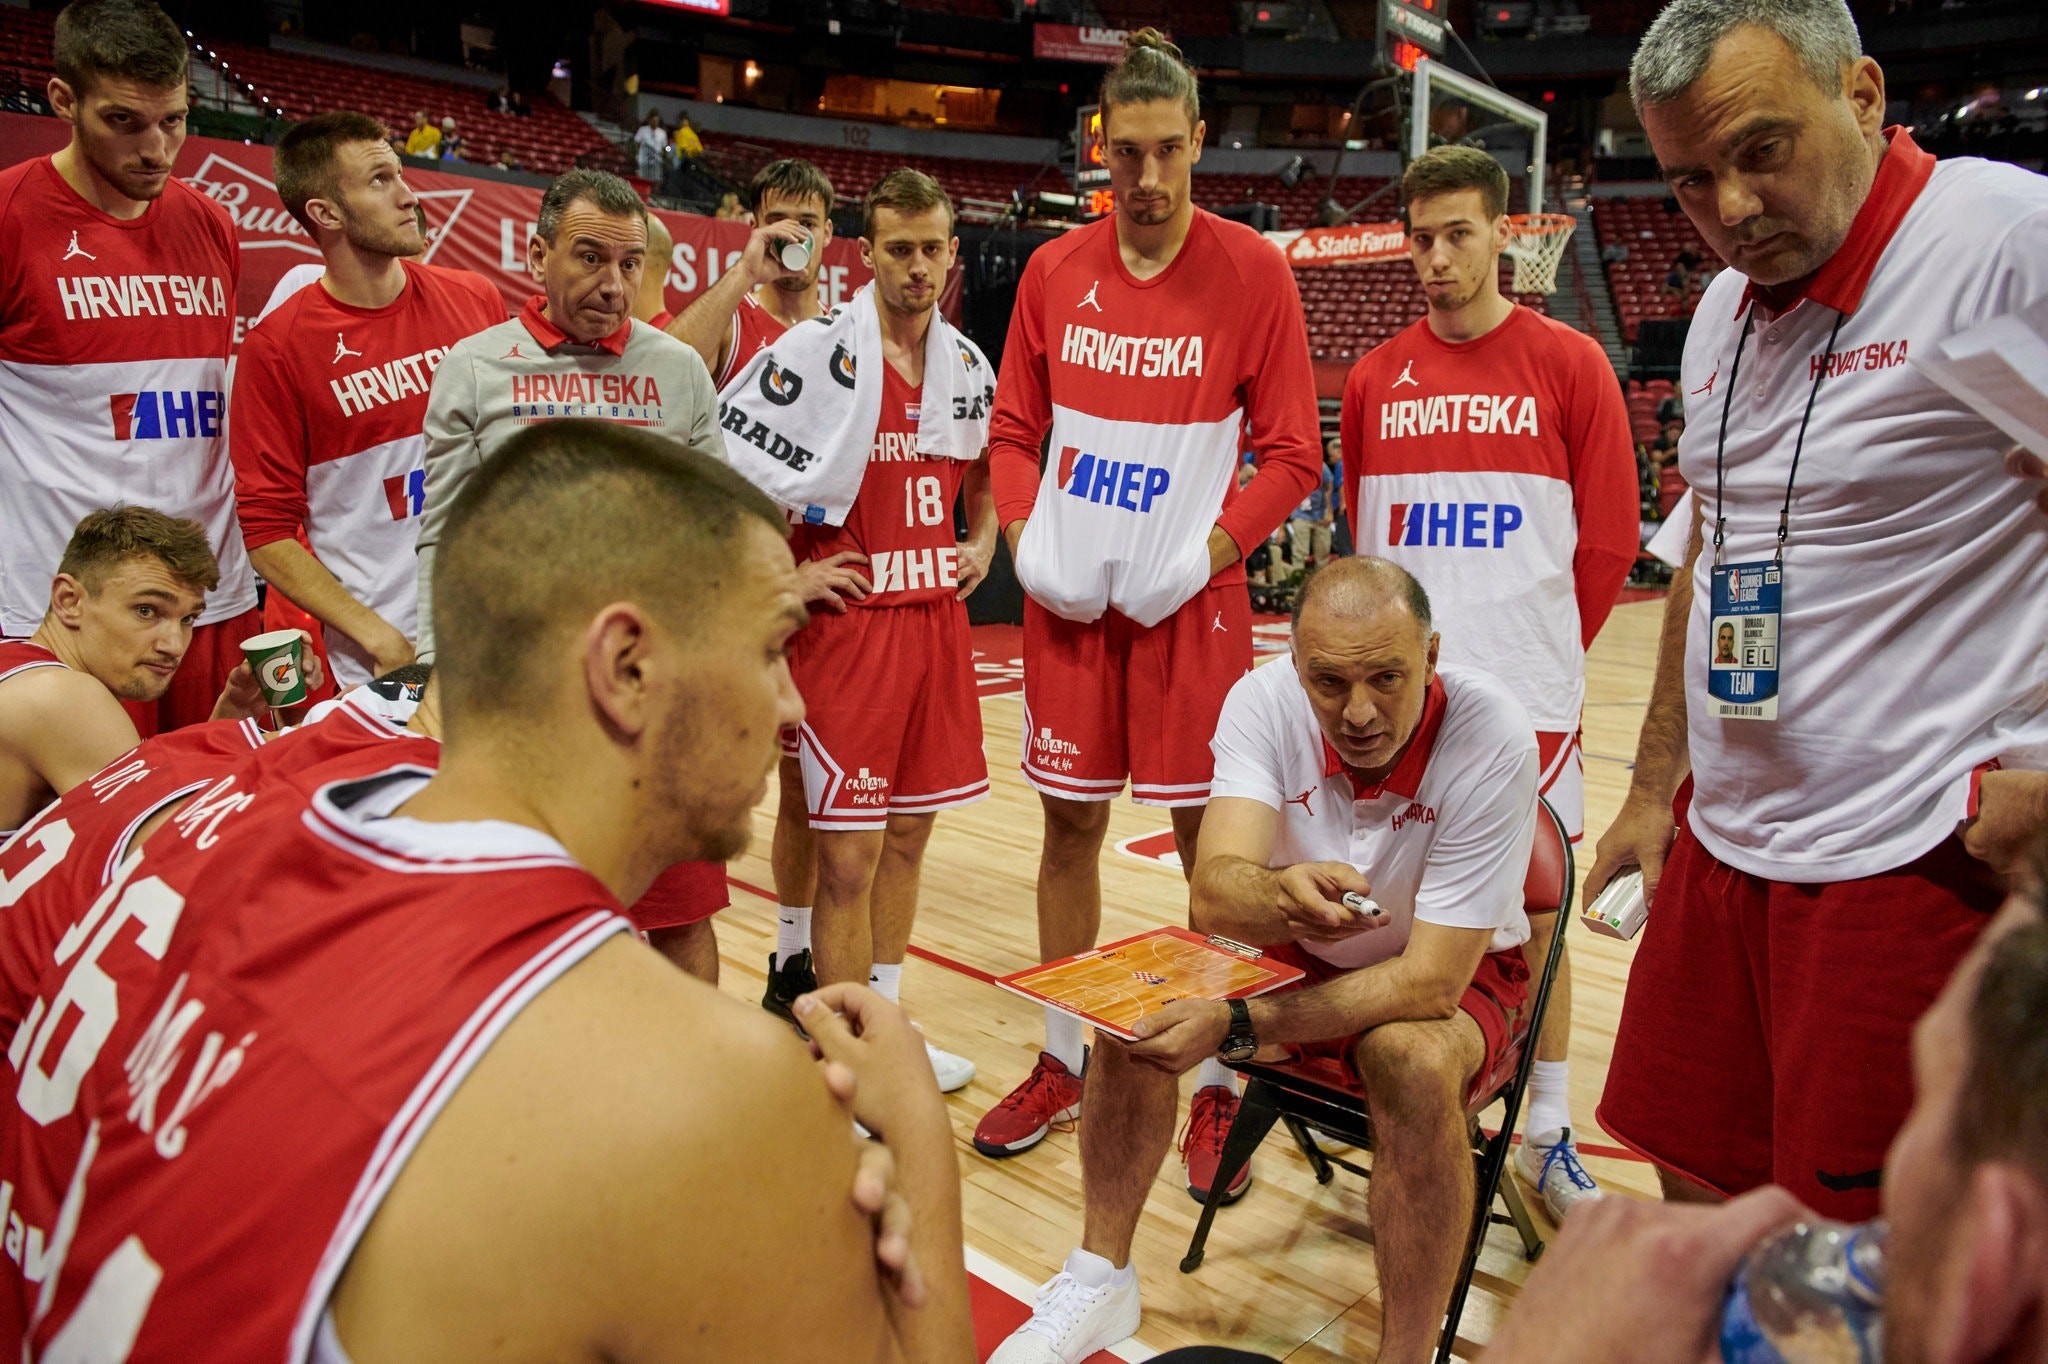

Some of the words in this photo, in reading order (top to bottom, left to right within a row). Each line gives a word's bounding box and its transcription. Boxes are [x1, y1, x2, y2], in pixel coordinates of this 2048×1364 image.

[842, 125, 871, 145] 102
[1316, 235, 1360, 258] State
[1359, 231, 1405, 254] Farm
[57, 275, 227, 320] HRVATSKA
[1061, 324, 1203, 377] HRVATSKA
[1809, 339, 1908, 381] HRVATSKA
[512, 373, 662, 406] HRVATSKA
[513, 405, 663, 419] BASKETBALL
[1380, 394, 1539, 440] HRVATSKA
[905, 476, 944, 527] 18
[1090, 459, 1170, 513] HEP
[1427, 502, 1523, 549] HEP
[1740, 588, 1759, 602] LEAGUE
[1746, 649, 1755, 664] E
[1762, 649, 1770, 664] L
[1730, 672, 1755, 695] TEAM
